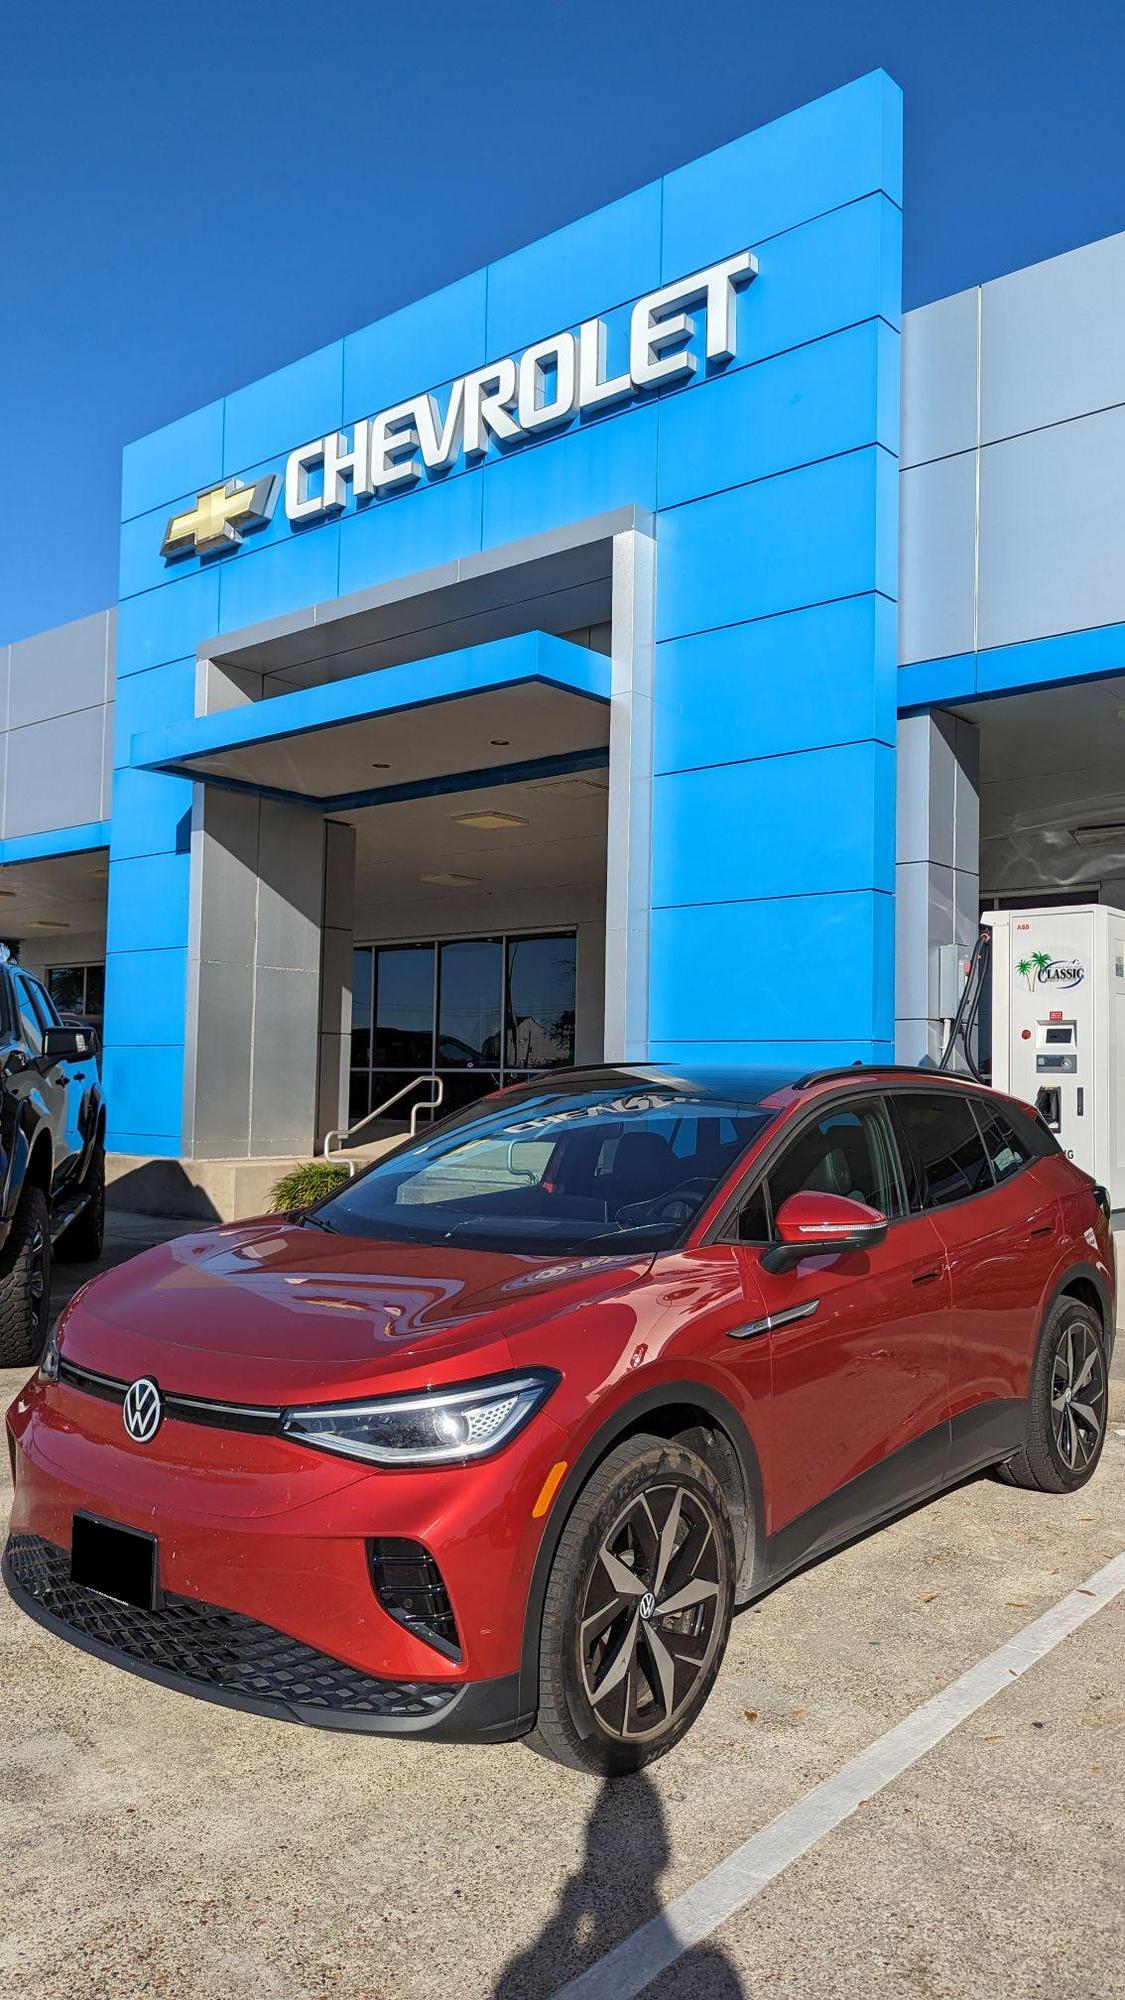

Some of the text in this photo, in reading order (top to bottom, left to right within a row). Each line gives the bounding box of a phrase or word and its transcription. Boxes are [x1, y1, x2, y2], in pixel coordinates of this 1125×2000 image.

[285, 251, 758, 523] CHEVROLET
[1017, 923, 1030, 931] ABB
[1038, 966, 1085, 983] CLASSIC
